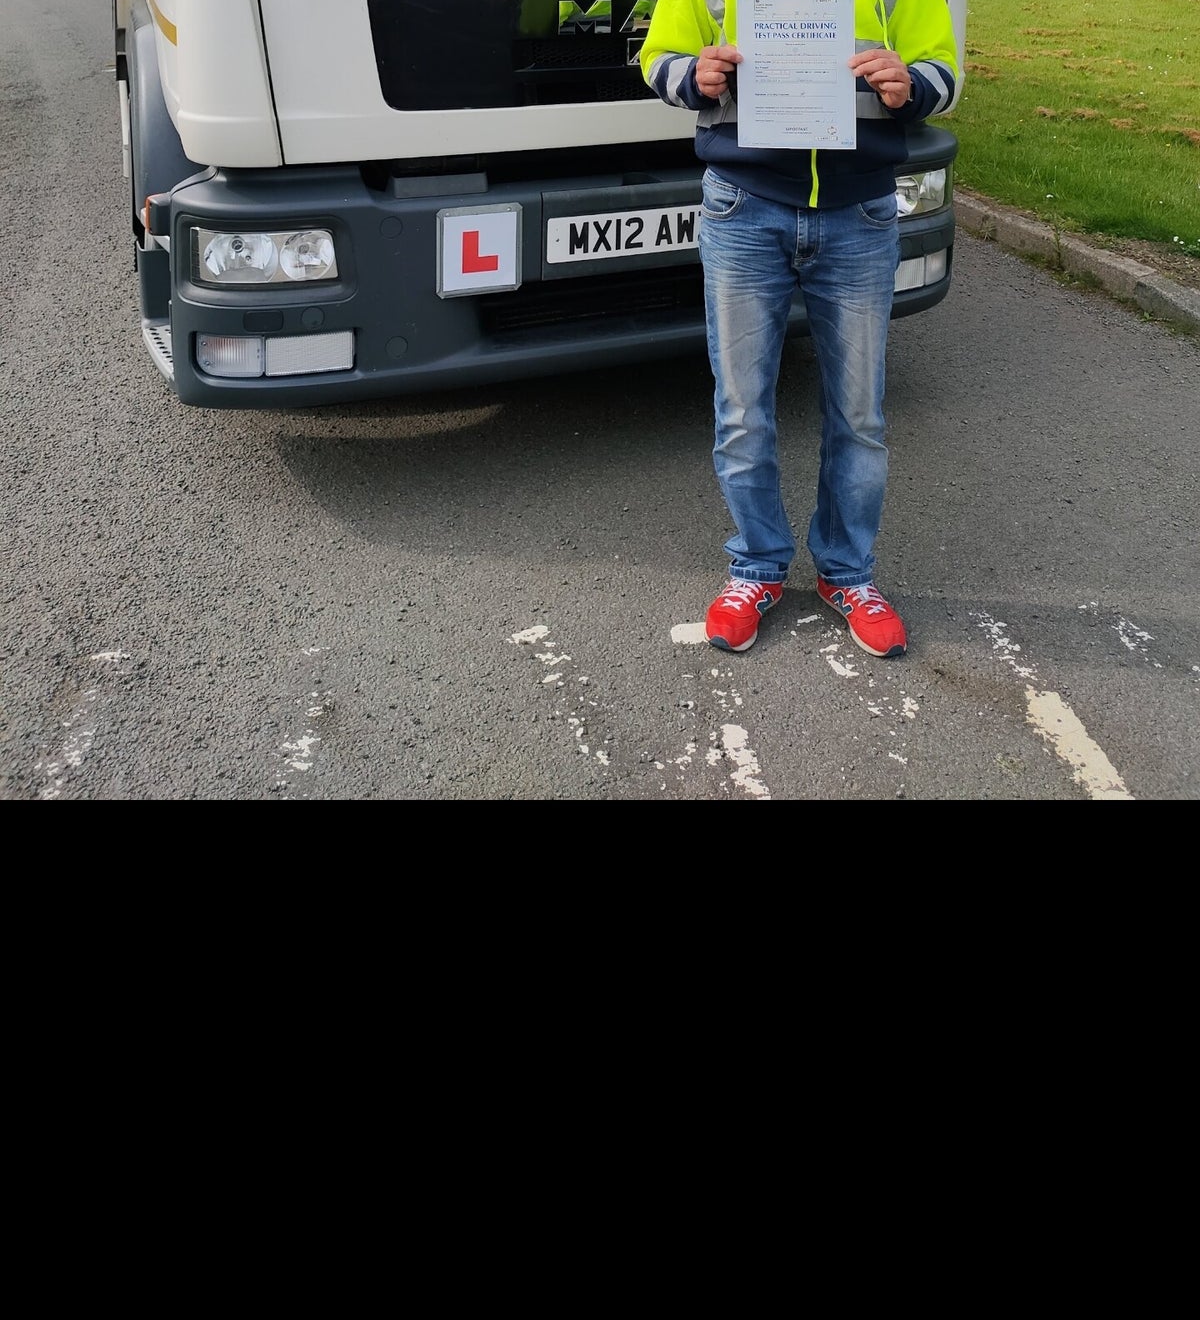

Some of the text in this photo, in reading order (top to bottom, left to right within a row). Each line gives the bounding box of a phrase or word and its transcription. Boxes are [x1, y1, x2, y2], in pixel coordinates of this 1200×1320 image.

[754, 22, 837, 30] PRACTICAL DRIVING
[462, 230, 498, 274] L
[569, 211, 701, 255] MX12 AW
